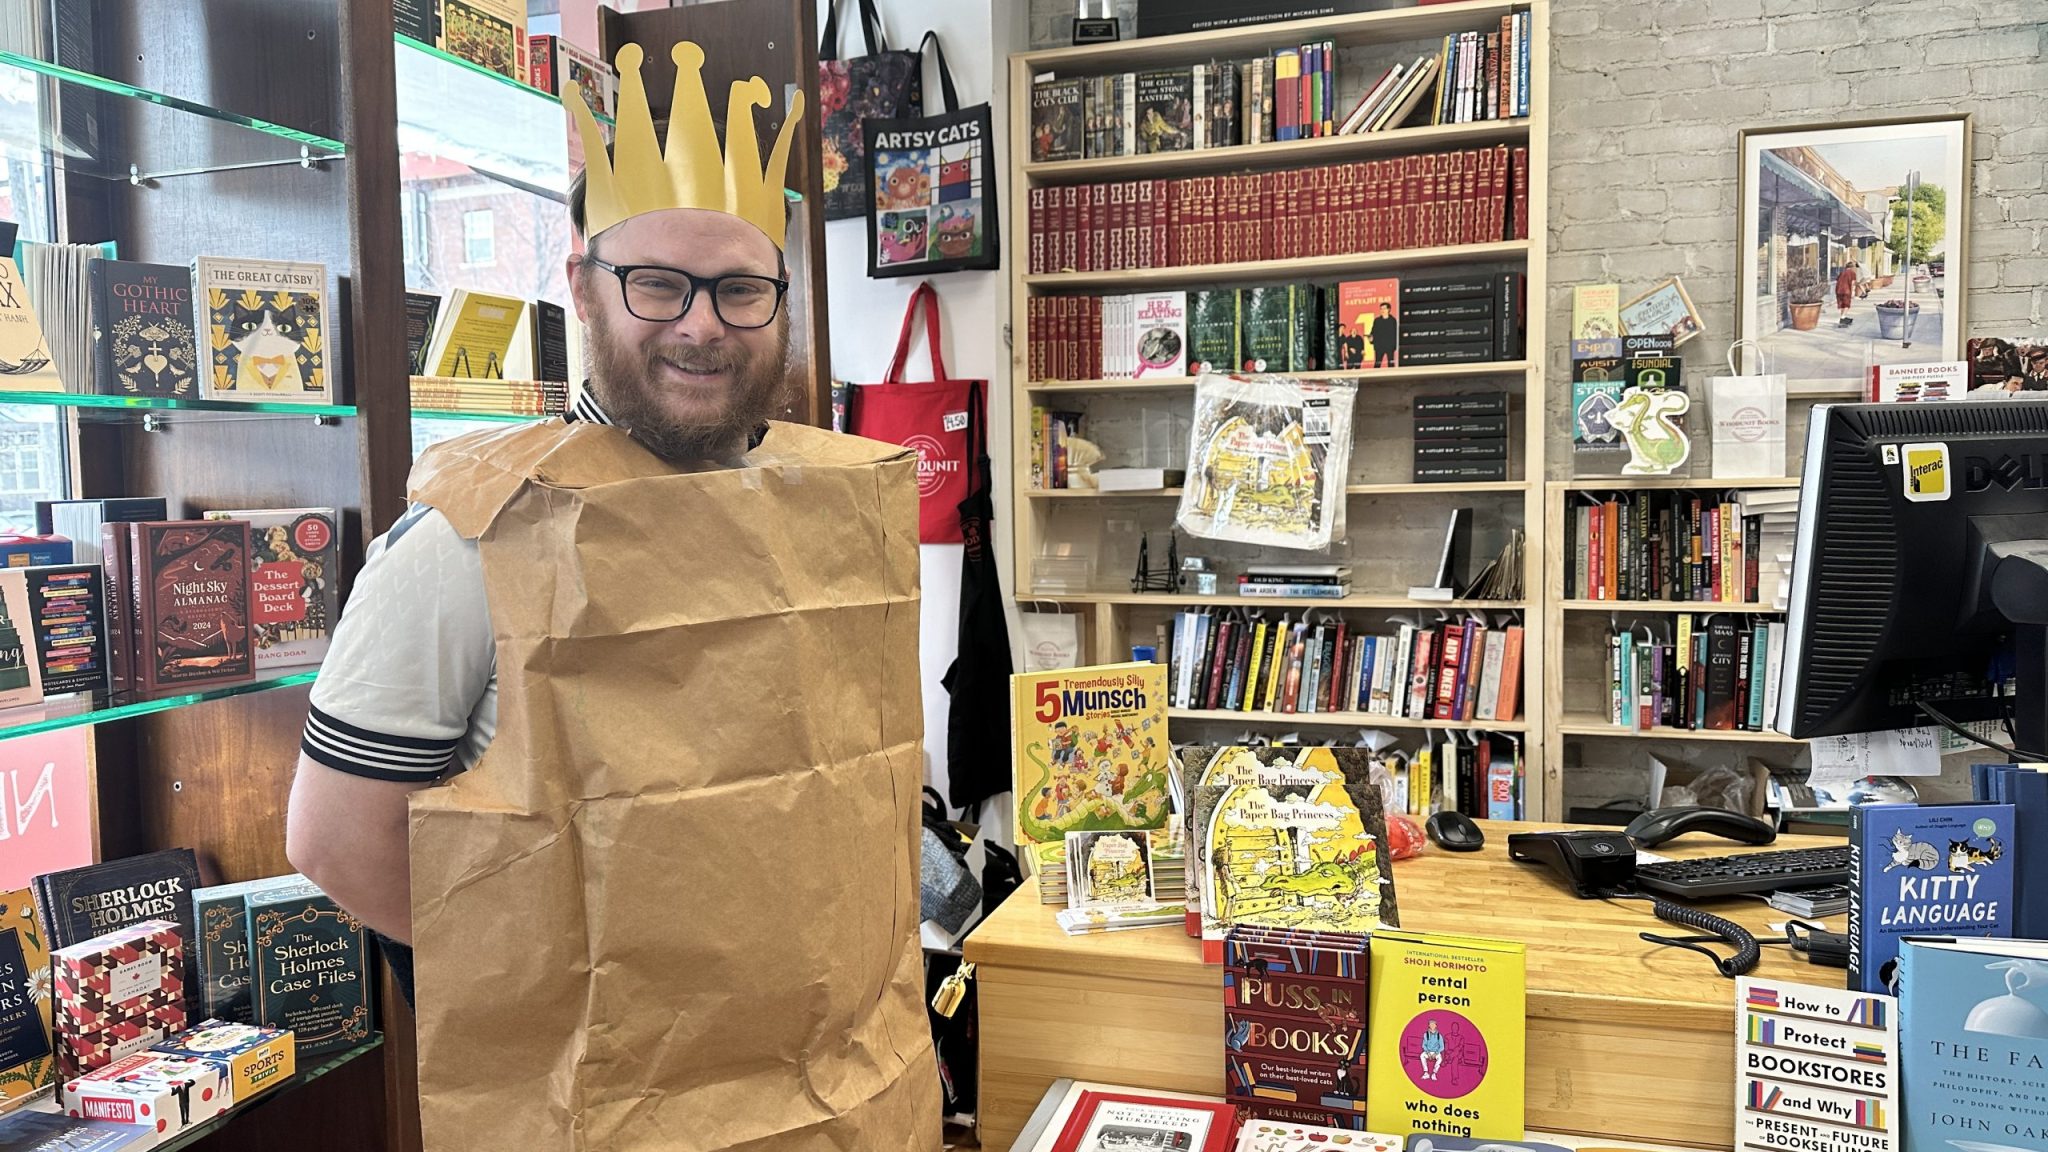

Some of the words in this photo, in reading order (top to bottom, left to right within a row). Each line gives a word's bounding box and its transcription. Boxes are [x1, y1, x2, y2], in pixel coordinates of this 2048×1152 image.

[1239, 13, 1283, 22] INTRODUCTION
[1139, 79, 1154, 88] THE
[1155, 78, 1174, 86] CLUE
[1139, 94, 1175, 103] LANTERN
[874, 130, 936, 149] ARTSY
[937, 120, 981, 144] CATS
[143, 276, 159, 284] MY
[213, 269, 235, 281] THE
[237, 271, 273, 283] GREAT
[274, 273, 314, 285] CATSBY
[113, 283, 188, 302] GOTHIC
[124, 300, 182, 316] HEART
[1138, 308, 1182, 319] KEATING
[1577, 342, 1617, 353] EMPTY
[1626, 338, 1655, 349] OPEN
[1636, 358, 1674, 369] SUNDIAL
[1888, 367, 1925, 376] BANNED
[1927, 365, 1958, 375] BOOKS
[1909, 457, 1944, 479] Interac
[1640, 520, 1648, 539] LEON
[1712, 511, 1720, 536] MARCH
[1711, 537, 1719, 565] VIOLETS
[264, 570, 288, 579] The
[1268, 576, 1285, 584] KING
[173, 583, 206, 597] Night
[206, 580, 228, 594] Sky
[253, 581, 300, 591] Dessert
[174, 594, 228, 607] ALMANAC
[259, 591, 295, 602] Board
[264, 602, 294, 613] Deck
[192, 621, 211, 630] 2024
[1322, 641, 1333, 674] ERAGON
[1712, 657, 1732, 665] CITY
[1064, 676, 1125, 690] Tremendously
[1126, 674, 1145, 690] Silly
[1035, 680, 1062, 724] 5
[1062, 687, 1147, 718] Munsch
[1086, 710, 1111, 721] stories
[1236, 765, 1253, 775] The
[1227, 775, 1256, 785] Paper
[1258, 774, 1276, 785] Bag
[1279, 775, 1321, 785] Princess
[1248, 800, 1266, 810] The
[1239, 809, 1269, 822] Paper
[1271, 809, 1290, 821] Bag
[1292, 809, 1335, 820] Princess
[1849, 843, 1861, 889] KITTY
[71, 877, 184, 914] SHERLOCK
[1900, 874, 1980, 902] KITTY
[88, 895, 176, 928] HOLMES
[1880, 901, 1998, 926] LANGUAGE
[1849, 889, 1860, 975] LANGUAGE
[1939, 924, 1975, 932] Understanding
[293, 933, 313, 944] The
[274, 937, 349, 962] Sherlock
[1406, 949, 1450, 960] INTERNATIONAL
[1451, 955, 1485, 963] BESTSELLER
[280, 957, 345, 977] Holmes
[1404, 957, 1431, 968] SHOJI
[1433, 960, 1487, 973] MORIMOTO
[219, 974, 251, 989] Cas
[270, 978, 312, 995] Case
[318, 969, 357, 987] Files
[1421, 974, 1467, 990] rental
[1241, 976, 1321, 1011] PUSS
[1331, 988, 1352, 1005] IN
[1418, 991, 1471, 1007] person
[1784, 996, 1820, 1012] How
[1826, 1004, 1840, 1015] to
[1247, 1022, 1350, 1056] BOOKS
[1784, 1026, 1847, 1049] Protect
[1931, 1040, 1990, 1062] THE
[2009, 1051, 2044, 1069] FA
[243, 1050, 285, 1077] SPORTS
[1260, 1062, 1275, 1071] Our
[1275, 1064, 1308, 1076] best-loved
[1309, 1069, 1332, 1078] writers
[1748, 1053, 1886, 1089] BOOKSTORES
[253, 1066, 277, 1083] TRIVIA
[1269, 1071, 1284, 1080] their
[1285, 1073, 1318, 1084] best-loved
[1319, 1078, 1333, 1086] cats
[1943, 1069, 1962, 1078] THE
[1968, 1073, 2017, 1086] HISTORY,
[2022, 1080, 2046, 1089] SCIE
[1933, 1081, 2003, 1097] PHILOSOPHY,
[2008, 1092, 2029, 1101] AND
[84, 1100, 133, 1120] MANIFESTO
[1268, 1108, 1290, 1119] PAUL
[1292, 1110, 1325, 1122] MAGRS
[1405, 1100, 1438, 1114] who
[1443, 1103, 1480, 1120] does
[1782, 1097, 1811, 1110] and
[1817, 1099, 1852, 1120] Why
[1971, 1100, 2004, 1111] DOING
[2010, 1106, 2048, 1116] WITHO
[1114, 1116, 1188, 1127] MURDERED
[1140, 1113, 1199, 1123] GETTING
[1931, 1112, 1991, 1132] JOHN
[2004, 1123, 2048, 1140] OAK
[1412, 1118, 1471, 1139] nothing
[1756, 1117, 1818, 1138] PRESENT
[1832, 1131, 1889, 1150] FUTURE
